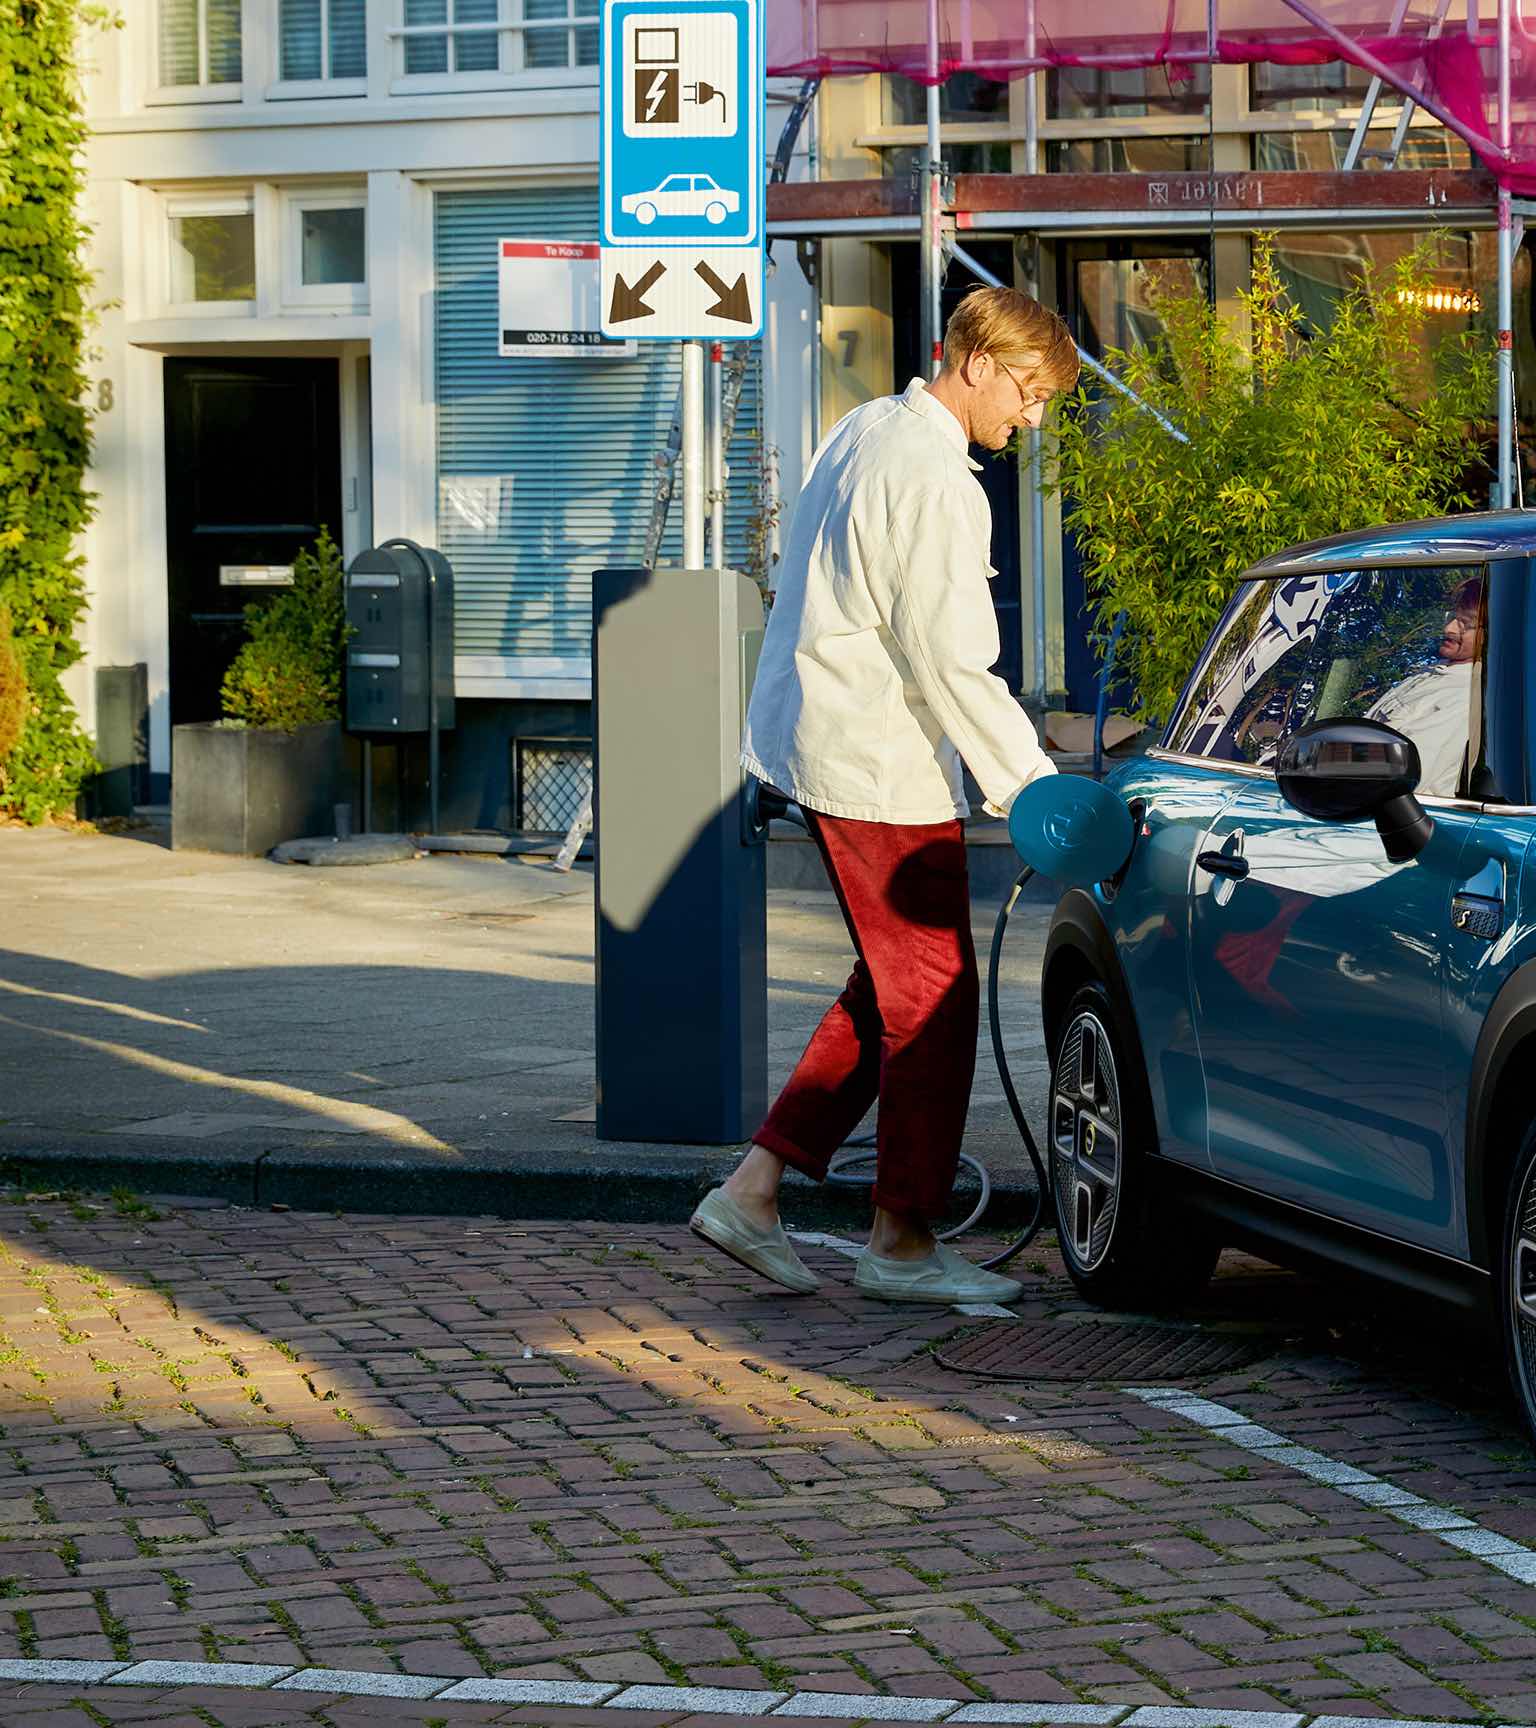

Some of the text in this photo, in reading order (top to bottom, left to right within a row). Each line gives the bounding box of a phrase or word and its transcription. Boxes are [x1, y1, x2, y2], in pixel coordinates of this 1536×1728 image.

[544, 246, 584, 257] Te Koop
[526, 332, 600, 343] 020-716 24 18
[837, 330, 858, 367] 7
[98, 379, 113, 412] 8
